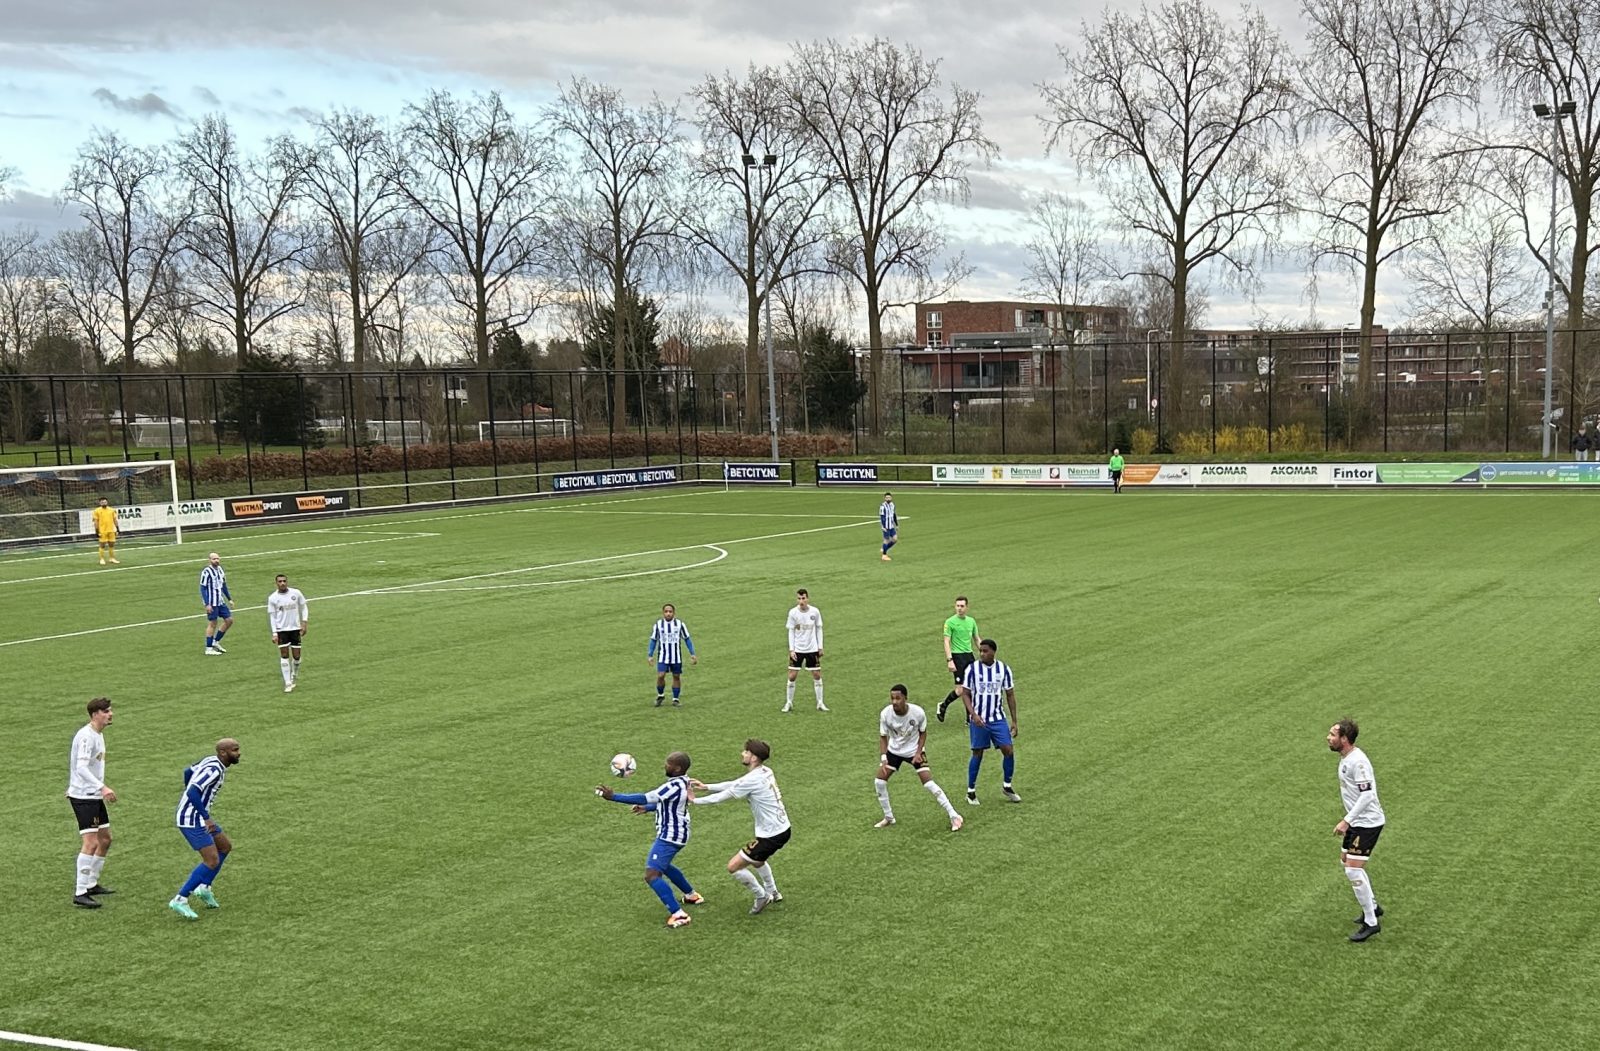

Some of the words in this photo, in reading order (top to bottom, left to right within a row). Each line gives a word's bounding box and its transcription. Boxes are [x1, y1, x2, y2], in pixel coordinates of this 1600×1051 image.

[730, 468, 779, 478] BETCITY.NL
[826, 468, 877, 479] BETCITY.NL
[954, 467, 985, 475] Nemad
[1010, 467, 1042, 475] Nemad
[1067, 467, 1100, 475] Nemad
[1201, 466, 1247, 475] AKOMAR
[1270, 466, 1318, 475] AKOMAR
[1333, 468, 1374, 478] Fintor
[1353, 836, 1360, 847] 4
